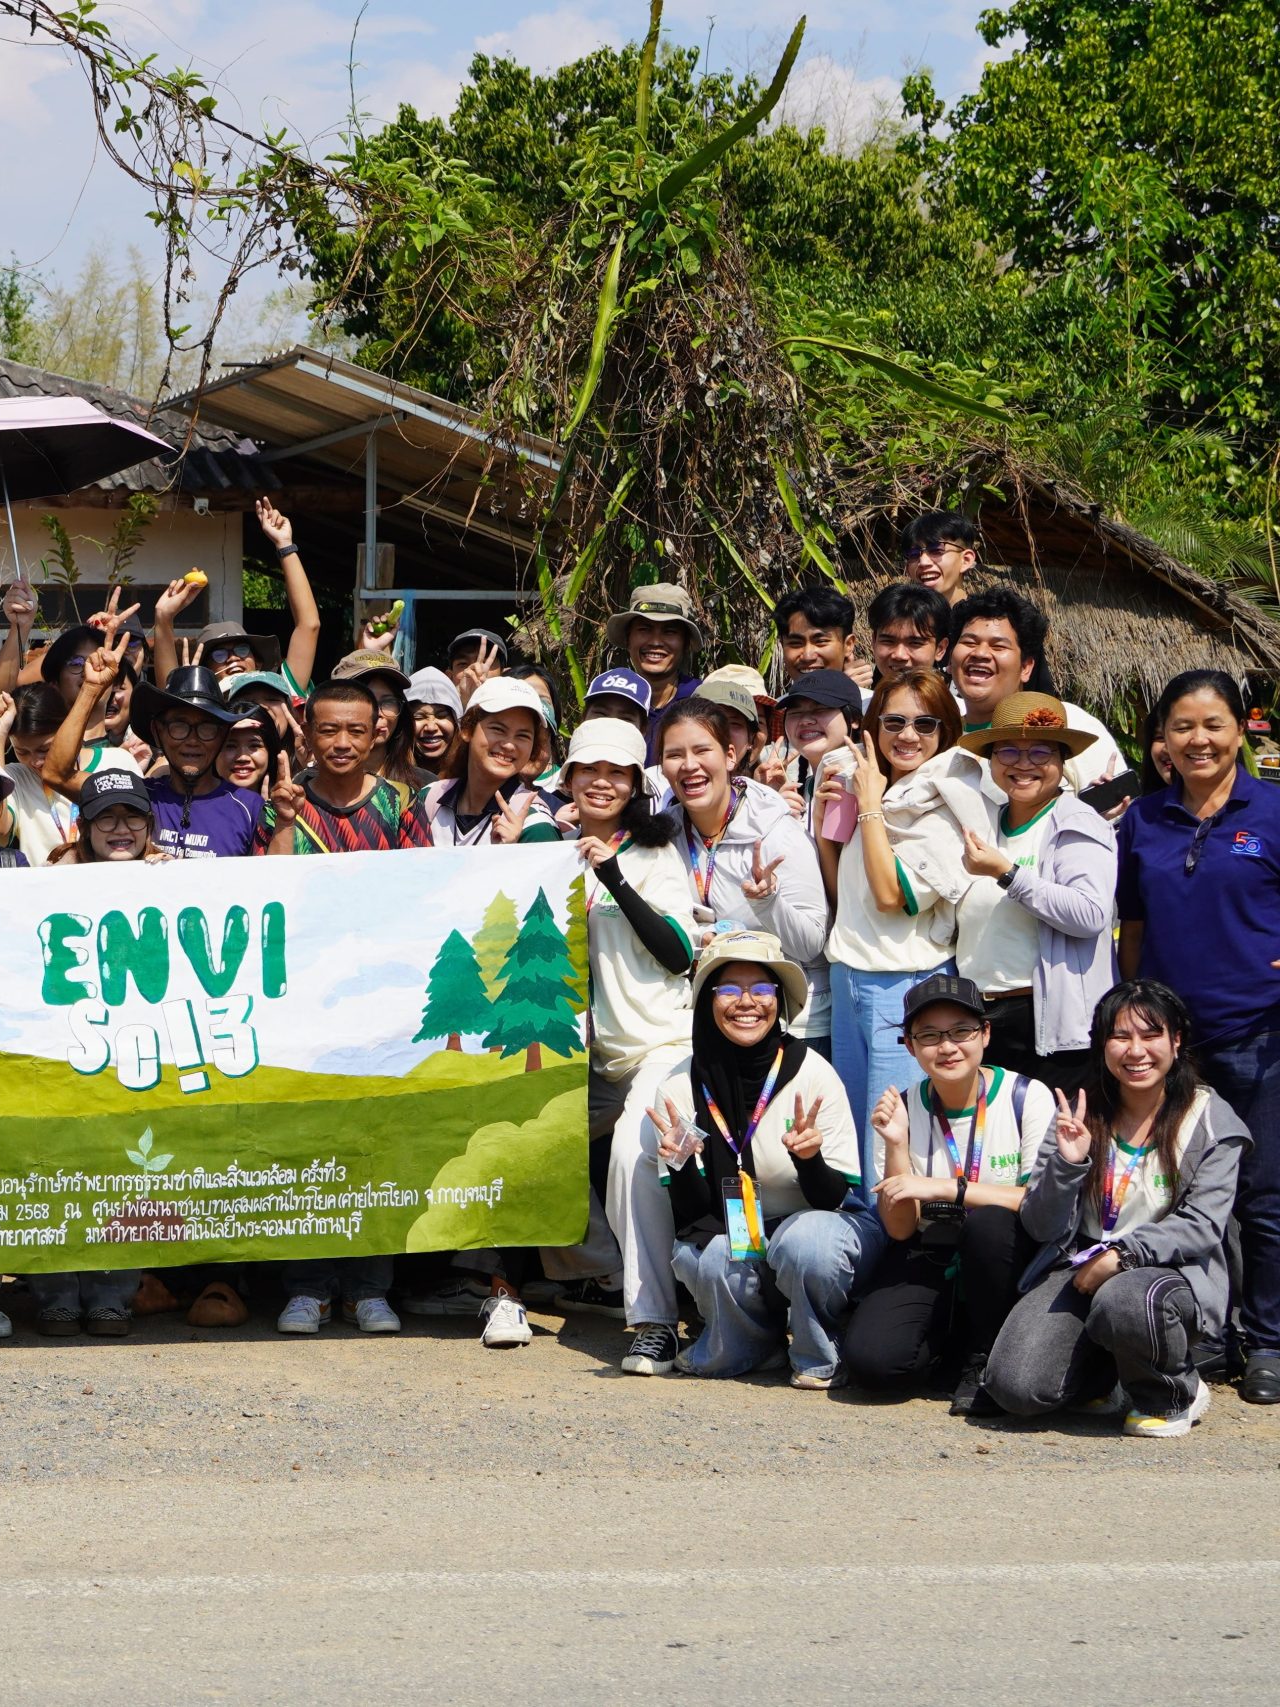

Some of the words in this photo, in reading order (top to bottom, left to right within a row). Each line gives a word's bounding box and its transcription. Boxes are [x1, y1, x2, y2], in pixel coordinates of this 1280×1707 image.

[37, 901, 287, 1006] ENVI
[16, 1203, 50, 1220] 2568
[64, 1202, 82, 1219] ณ
